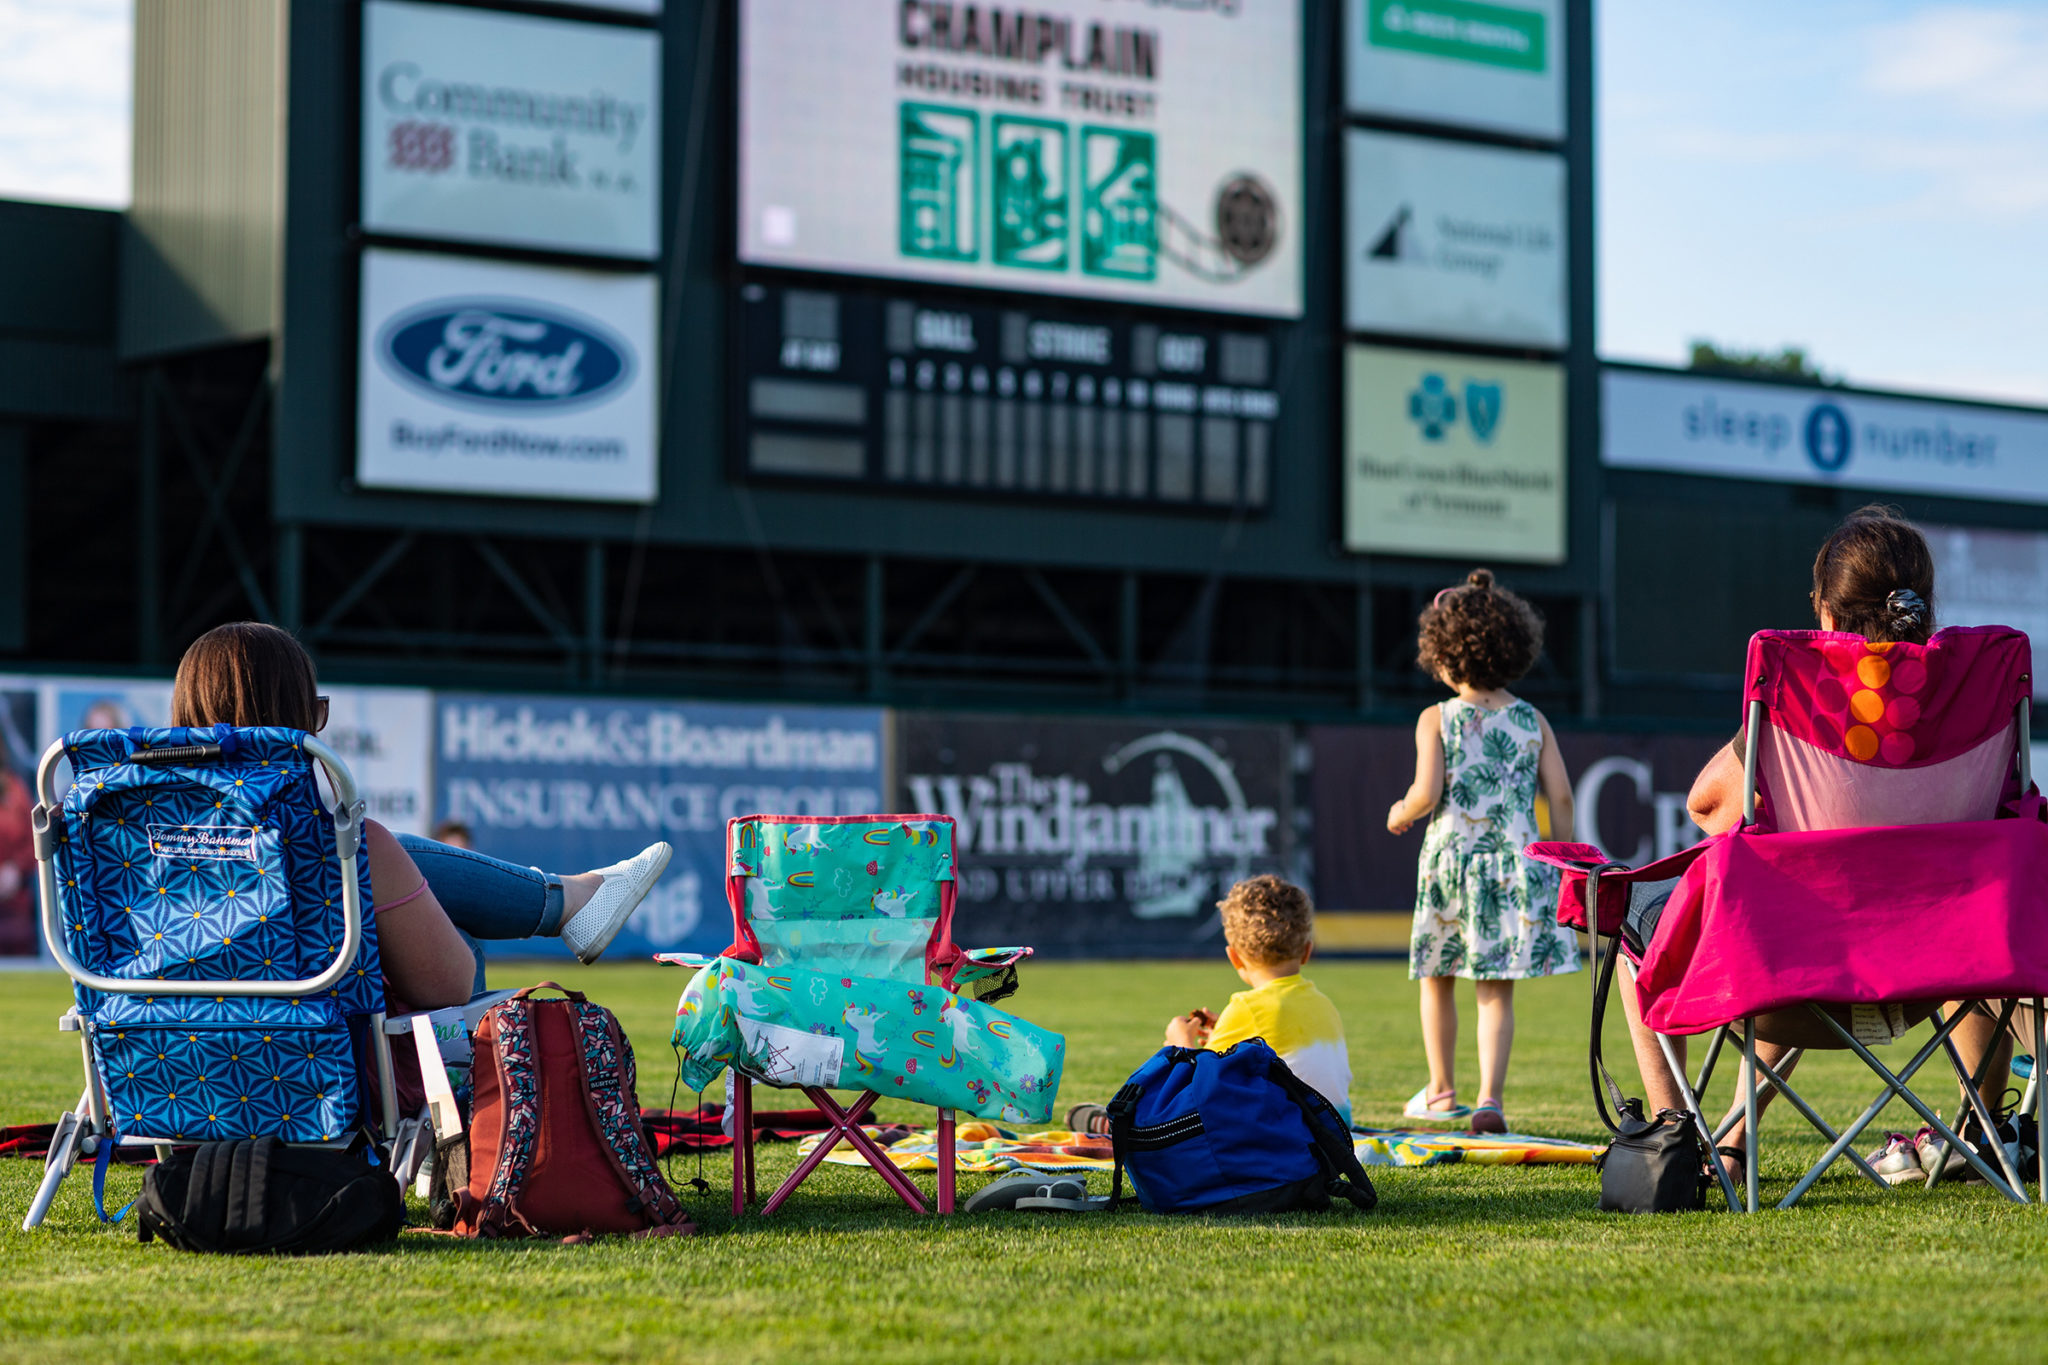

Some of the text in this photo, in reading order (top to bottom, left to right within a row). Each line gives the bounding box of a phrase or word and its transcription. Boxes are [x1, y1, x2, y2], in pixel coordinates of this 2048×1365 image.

[898, 0, 1159, 80] CHAMPLAIN
[378, 60, 645, 154] Community
[898, 63, 1158, 118] HOUSING TRUST
[466, 126, 581, 189] Bank
[426, 309, 586, 396] Ford
[915, 309, 977, 353] BALL
[1029, 320, 1112, 366] STRIKE
[1683, 393, 1998, 468] sleep number
[446, 777, 722, 831] INSURANCE
[152, 828, 252, 848] Tommy Bahama
[590, 1079, 618, 1089] BURTON
